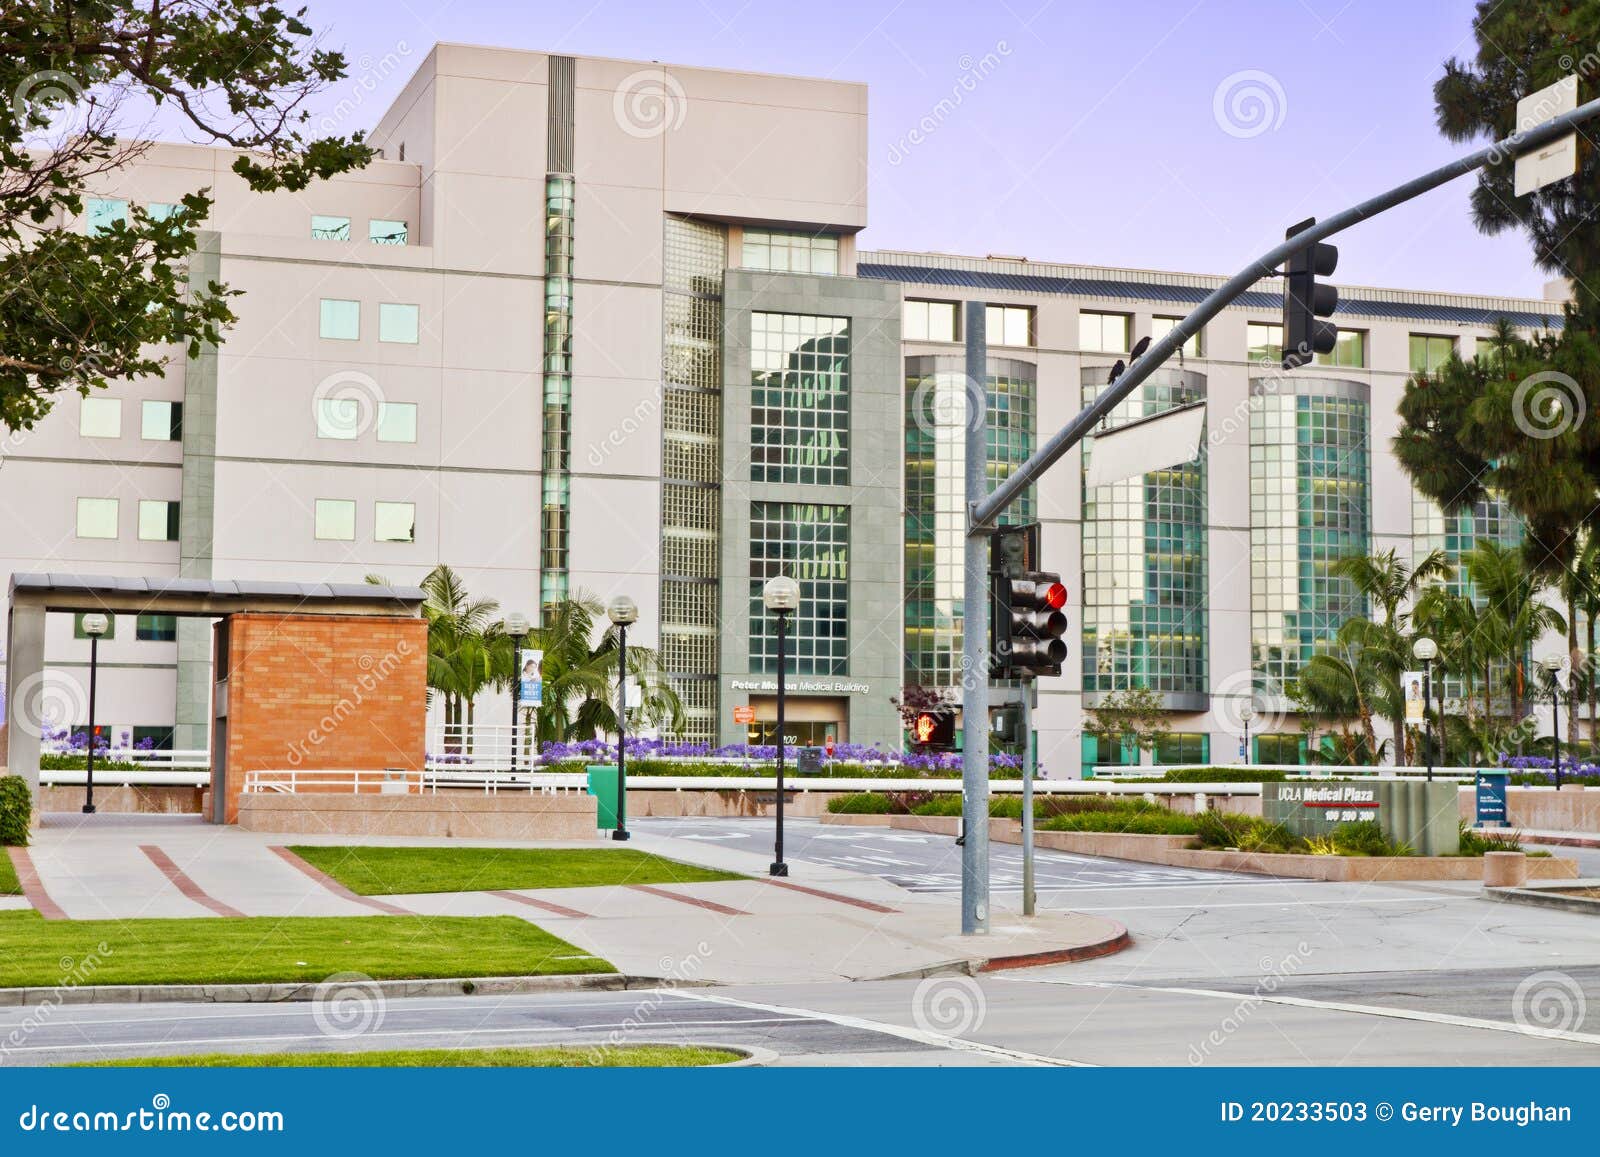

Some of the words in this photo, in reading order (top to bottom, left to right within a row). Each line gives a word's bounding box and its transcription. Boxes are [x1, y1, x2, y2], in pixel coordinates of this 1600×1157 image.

[731, 680, 760, 690] Peter
[799, 682, 833, 691] Medical
[834, 683, 870, 694] Building
[1278, 787, 1302, 801] UCLA
[1303, 787, 1343, 801] Medical
[1343, 787, 1374, 801] Plaza
[1325, 810, 1340, 822] 100
[1341, 810, 1357, 822] 200
[1358, 810, 1375, 822] 300
